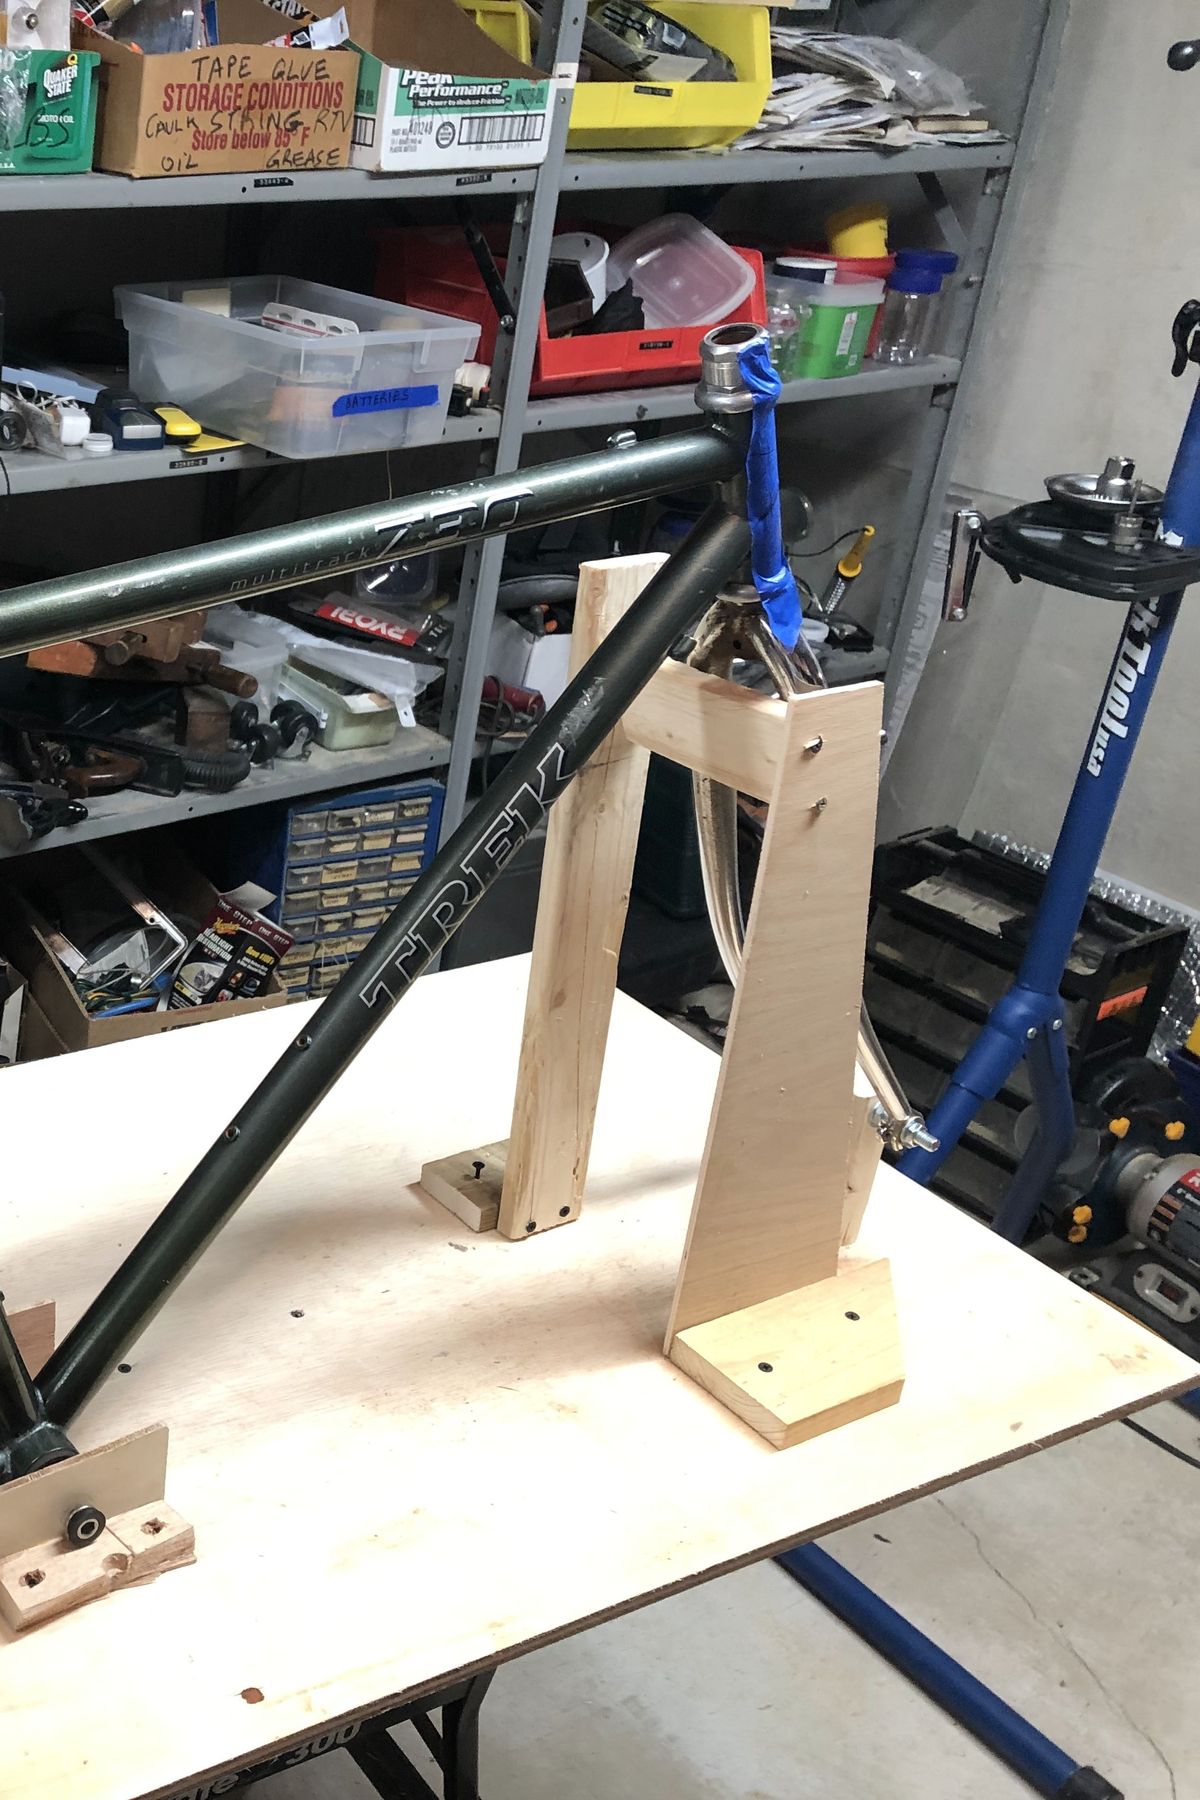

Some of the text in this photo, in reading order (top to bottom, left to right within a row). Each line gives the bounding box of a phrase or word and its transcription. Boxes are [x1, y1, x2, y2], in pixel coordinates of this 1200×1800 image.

[43, 65, 79, 90] QUAKER
[192, 54, 330, 84] TAPE GLUE
[47, 80, 72, 98] STATE
[162, 82, 245, 112] STORAGE
[248, 80, 344, 111] CONDITIONS
[145, 108, 354, 139] CAULK STRING RTV
[191, 129, 228, 151] Store
[231, 126, 271, 149] below
[265, 147, 340, 169] GREASE
[345, 389, 410, 410] BATTERIES
[228, 545, 370, 592] multitrack
[329, 605, 410, 642] RYOBI
[1100, 635, 1151, 739] Tool
[359, 741, 579, 1008] TREK
[195, 932, 234, 962] RESTORATION
[202, 927, 235, 953] HEADLIGHT
